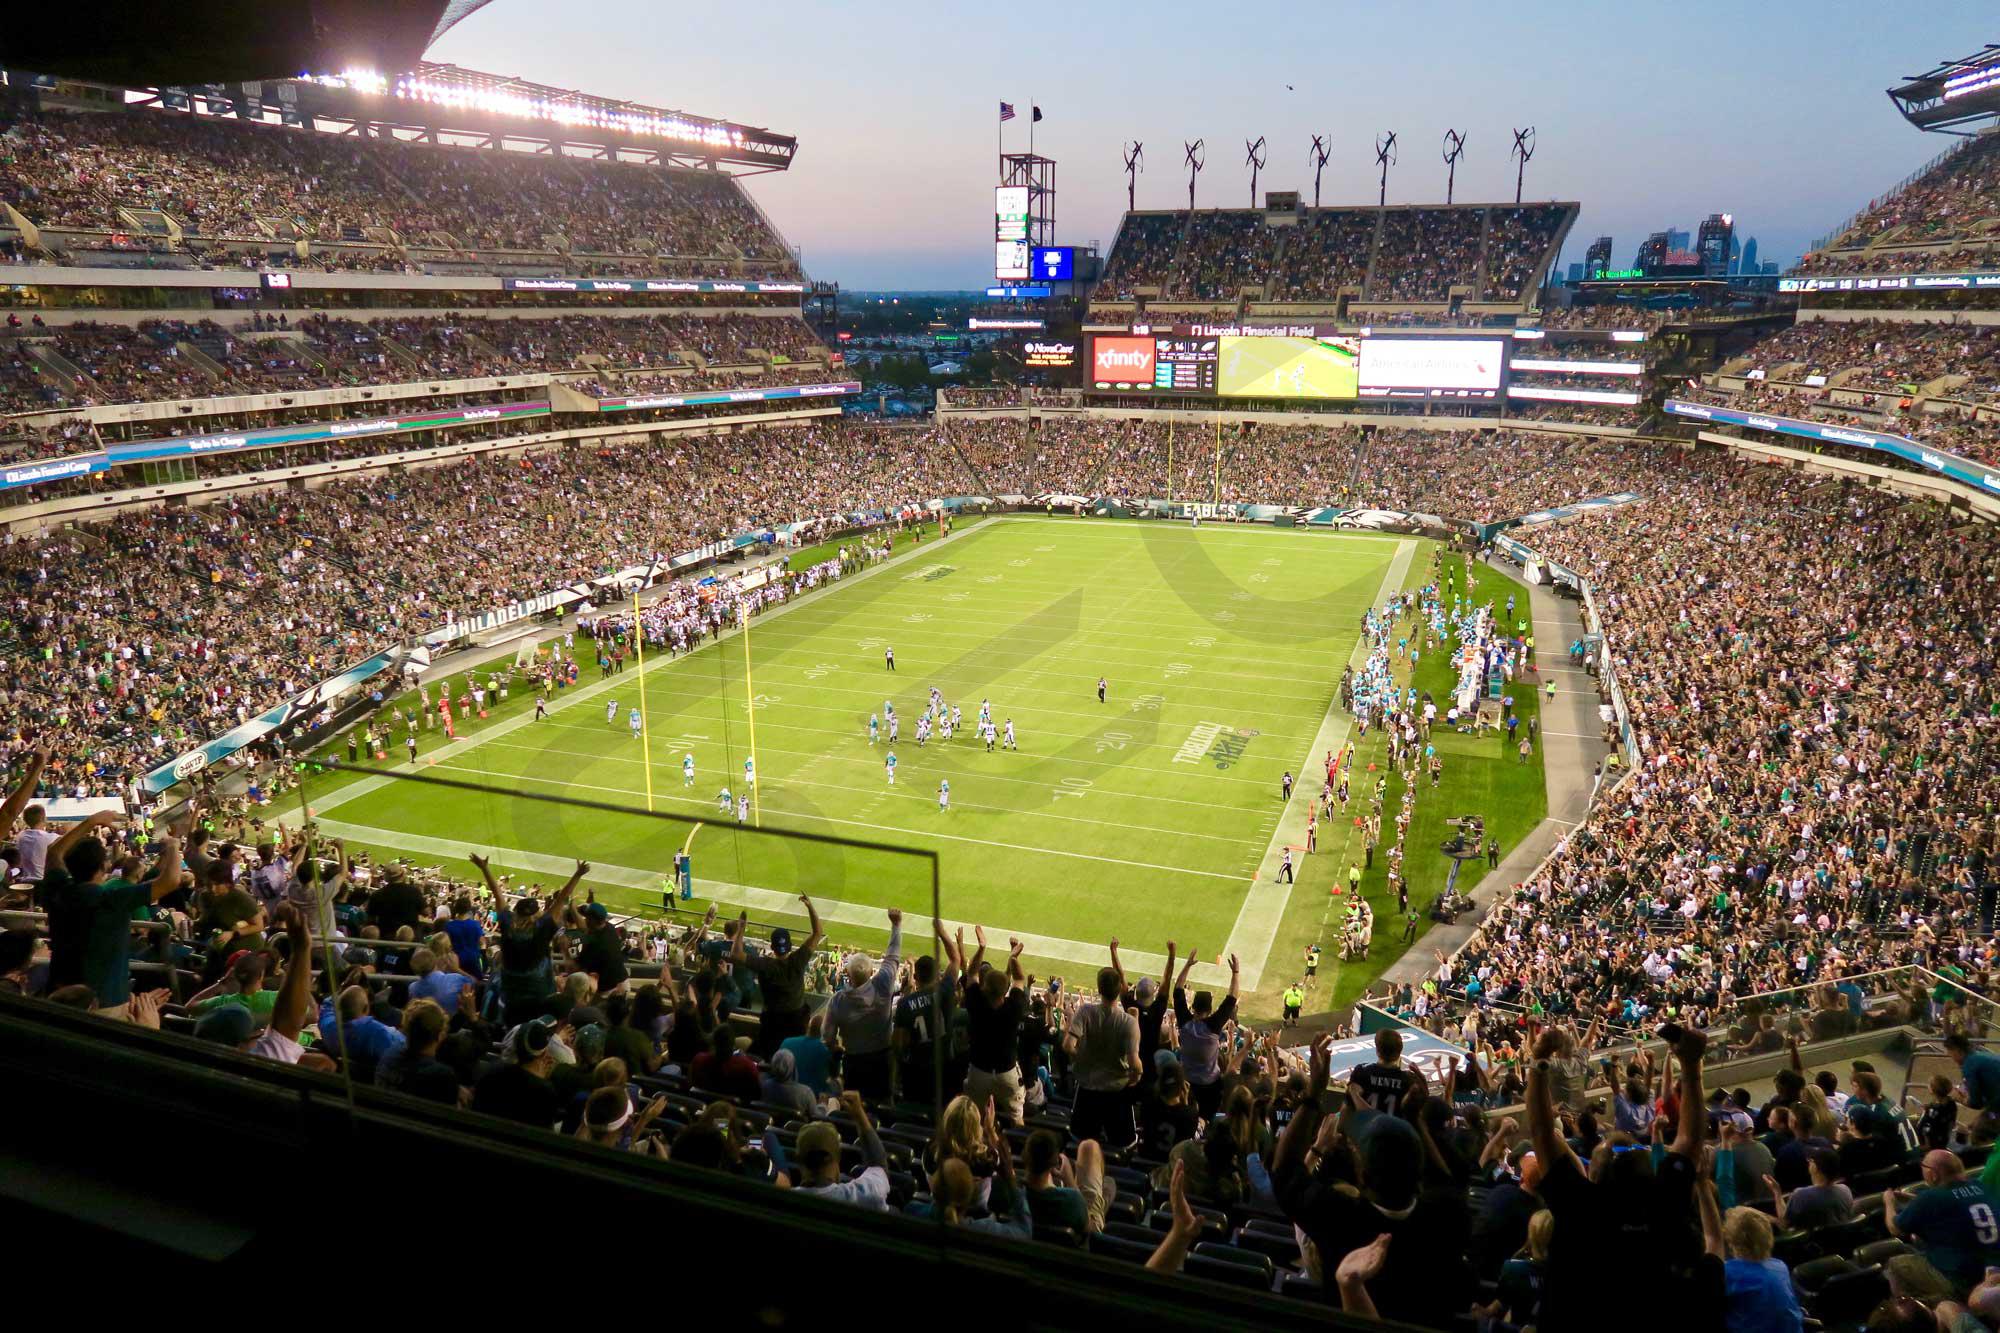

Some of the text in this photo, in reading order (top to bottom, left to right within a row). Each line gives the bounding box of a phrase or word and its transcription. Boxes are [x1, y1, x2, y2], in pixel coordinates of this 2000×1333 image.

[1204, 326, 1315, 337] Lincoln Financial Field
[1034, 343, 1074, 353] NovaCare
[1192, 342, 1197, 351] 7
[1097, 348, 1151, 368] xfinity
[447, 592, 562, 637] PHILADELPHIA
[666, 733, 709, 749] 10
[1096, 732, 1133, 751] 20
[1053, 777, 1094, 798] 10
[1370, 1076, 1402, 1088] WENTZ
[1898, 1118, 1920, 1151] 11
[1969, 1203, 1999, 1245] 9
